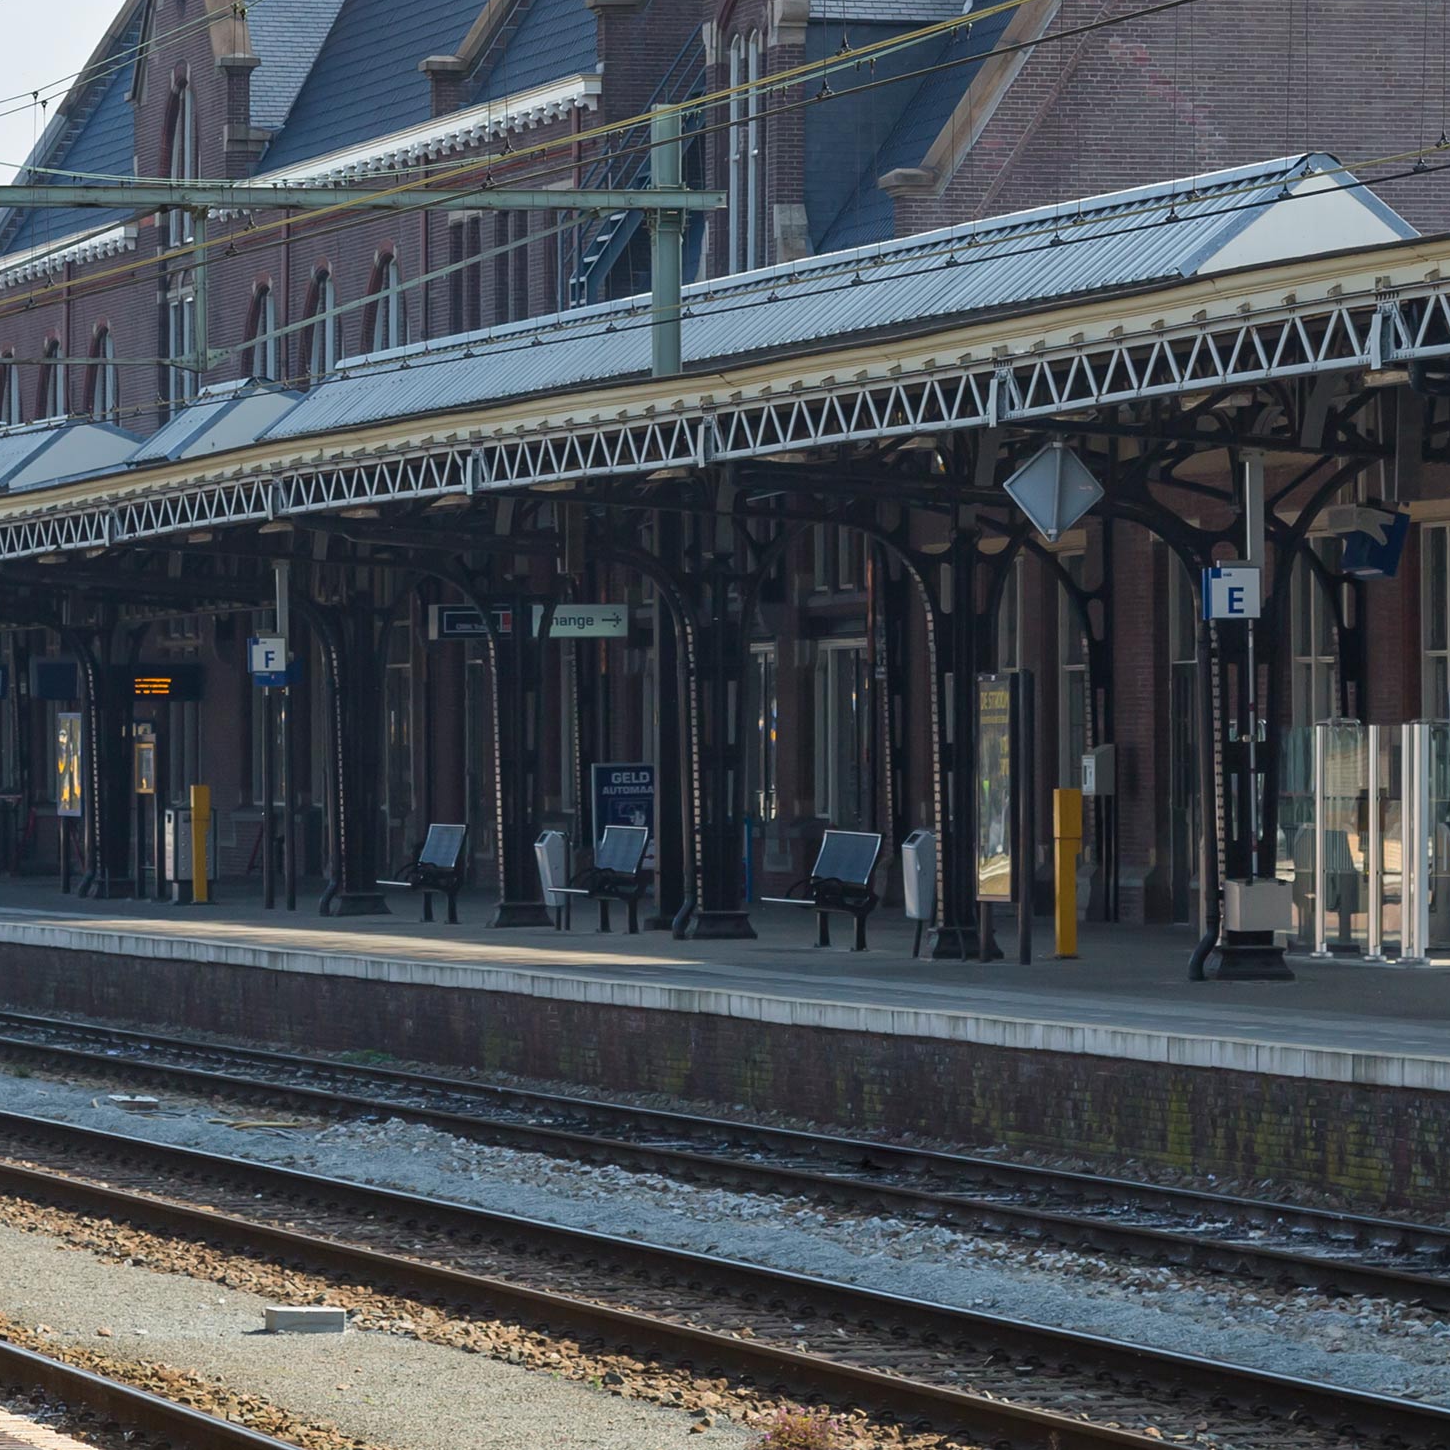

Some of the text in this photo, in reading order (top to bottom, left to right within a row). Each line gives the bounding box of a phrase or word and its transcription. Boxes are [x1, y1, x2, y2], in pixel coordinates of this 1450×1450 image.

[1228, 587, 1244, 614] E
[264, 650, 275, 668] F
[611, 772, 650, 784] GELD
[602, 786, 655, 795] AUTOMAA
